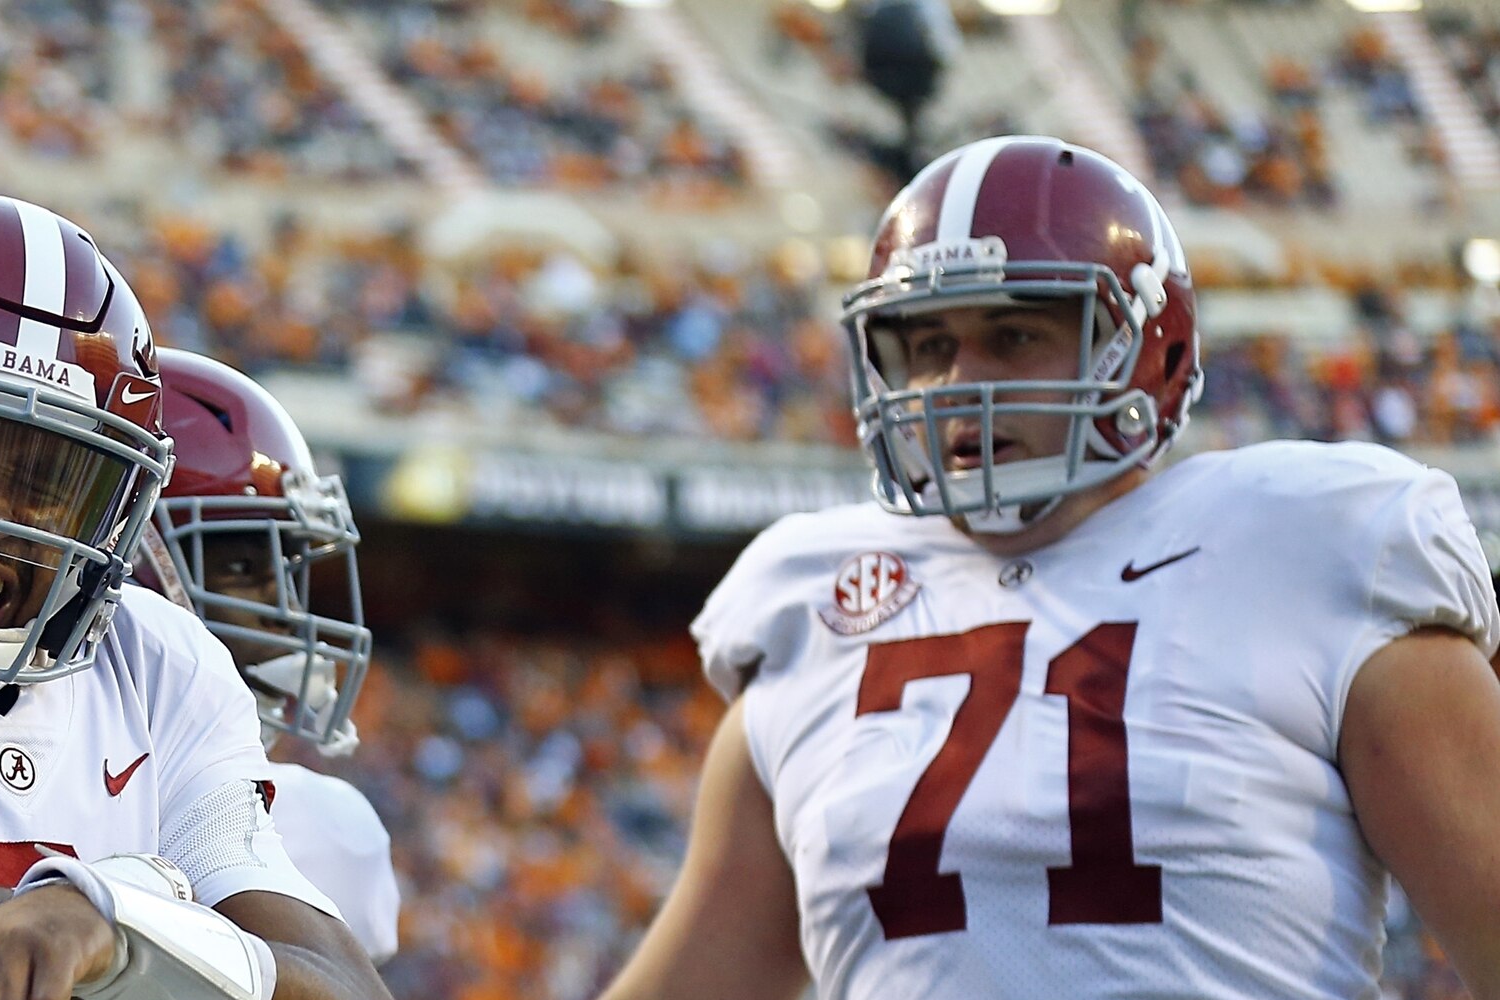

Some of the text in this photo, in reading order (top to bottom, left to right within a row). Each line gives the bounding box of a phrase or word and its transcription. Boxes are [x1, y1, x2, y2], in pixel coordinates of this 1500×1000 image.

[3, 350, 70, 387] BAMA
[837, 552, 902, 614] SEC
[5, 753, 30, 781] A
[855, 620, 1163, 940] 71
